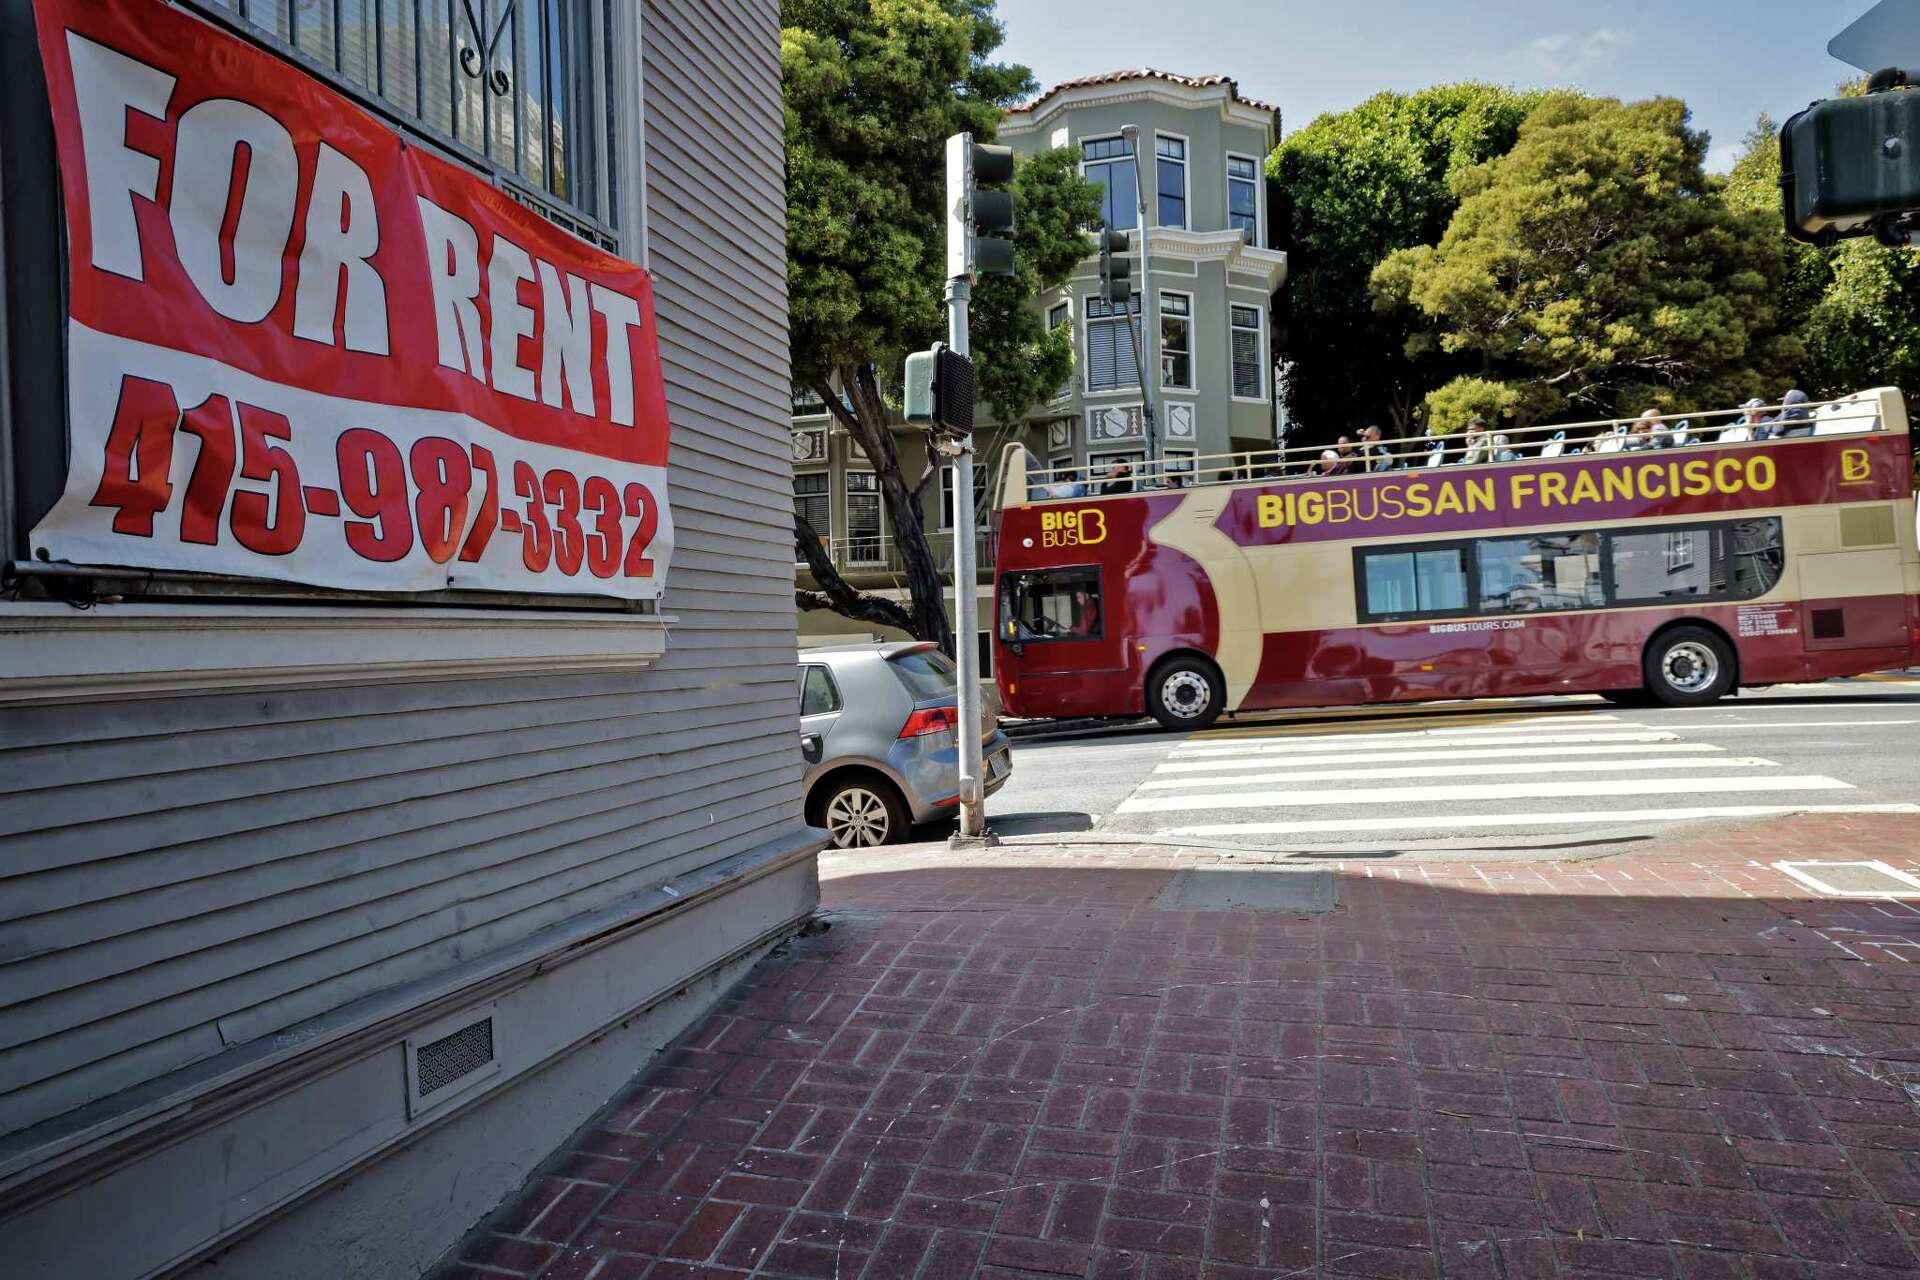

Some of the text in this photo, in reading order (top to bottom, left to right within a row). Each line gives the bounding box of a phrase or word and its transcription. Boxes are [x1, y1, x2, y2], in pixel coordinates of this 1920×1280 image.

[64, 28, 642, 428] FOR RENT
[88, 373, 659, 579] 415-987-3332
[1510, 455, 1777, 510] FRANCISCO
[1041, 511, 1077, 531] BIG
[1042, 528, 1079, 548] BUS
[1429, 620, 1526, 634] BIGBUSTOURS.COM
